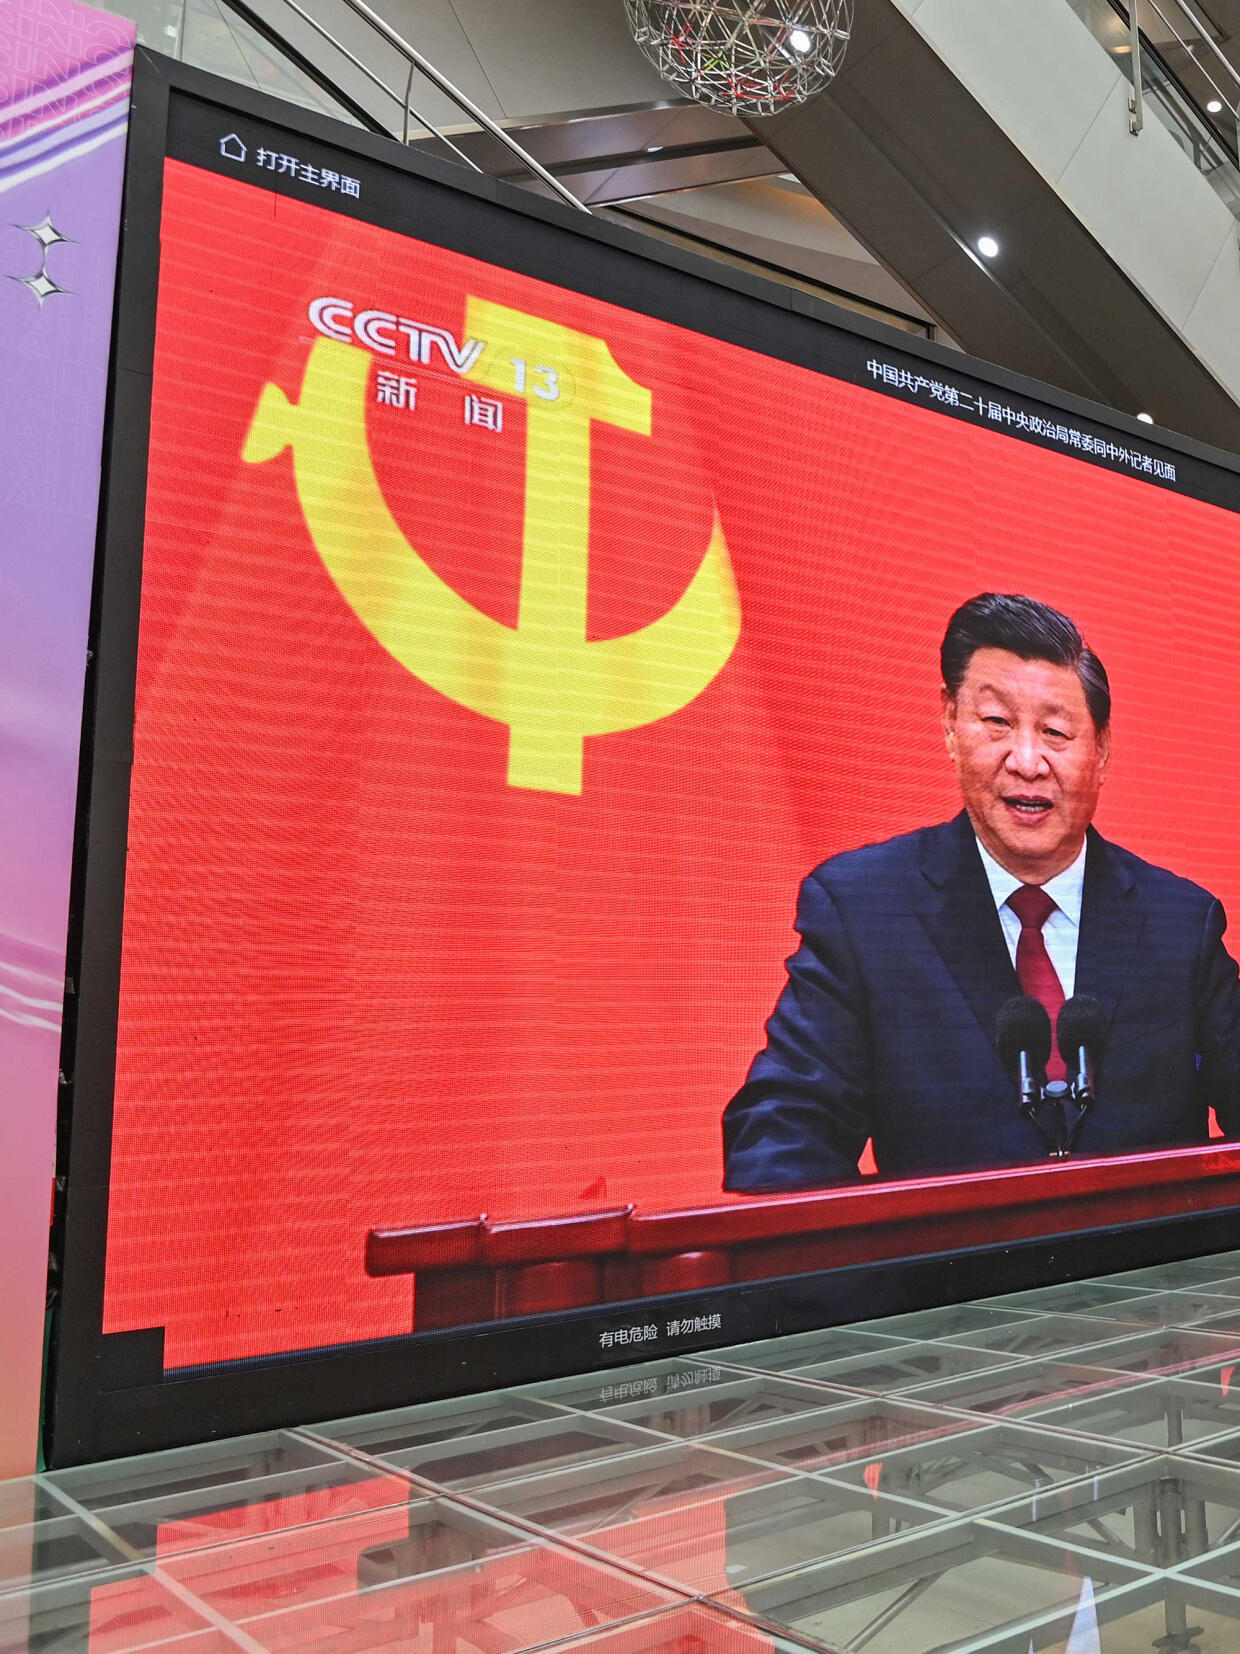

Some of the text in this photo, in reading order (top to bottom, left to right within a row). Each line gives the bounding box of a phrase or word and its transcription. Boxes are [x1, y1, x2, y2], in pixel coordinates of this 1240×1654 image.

[256, 147, 361, 199] 打开主界面
[309, 296, 560, 401] CCTV 13
[377, 371, 503, 432] 新闻
[866, 358, 1176, 483] 中国共产党第二十届中央政治局常委同中外记者见面
[599, 1313, 722, 1349] 有电危险 请勿触摸
